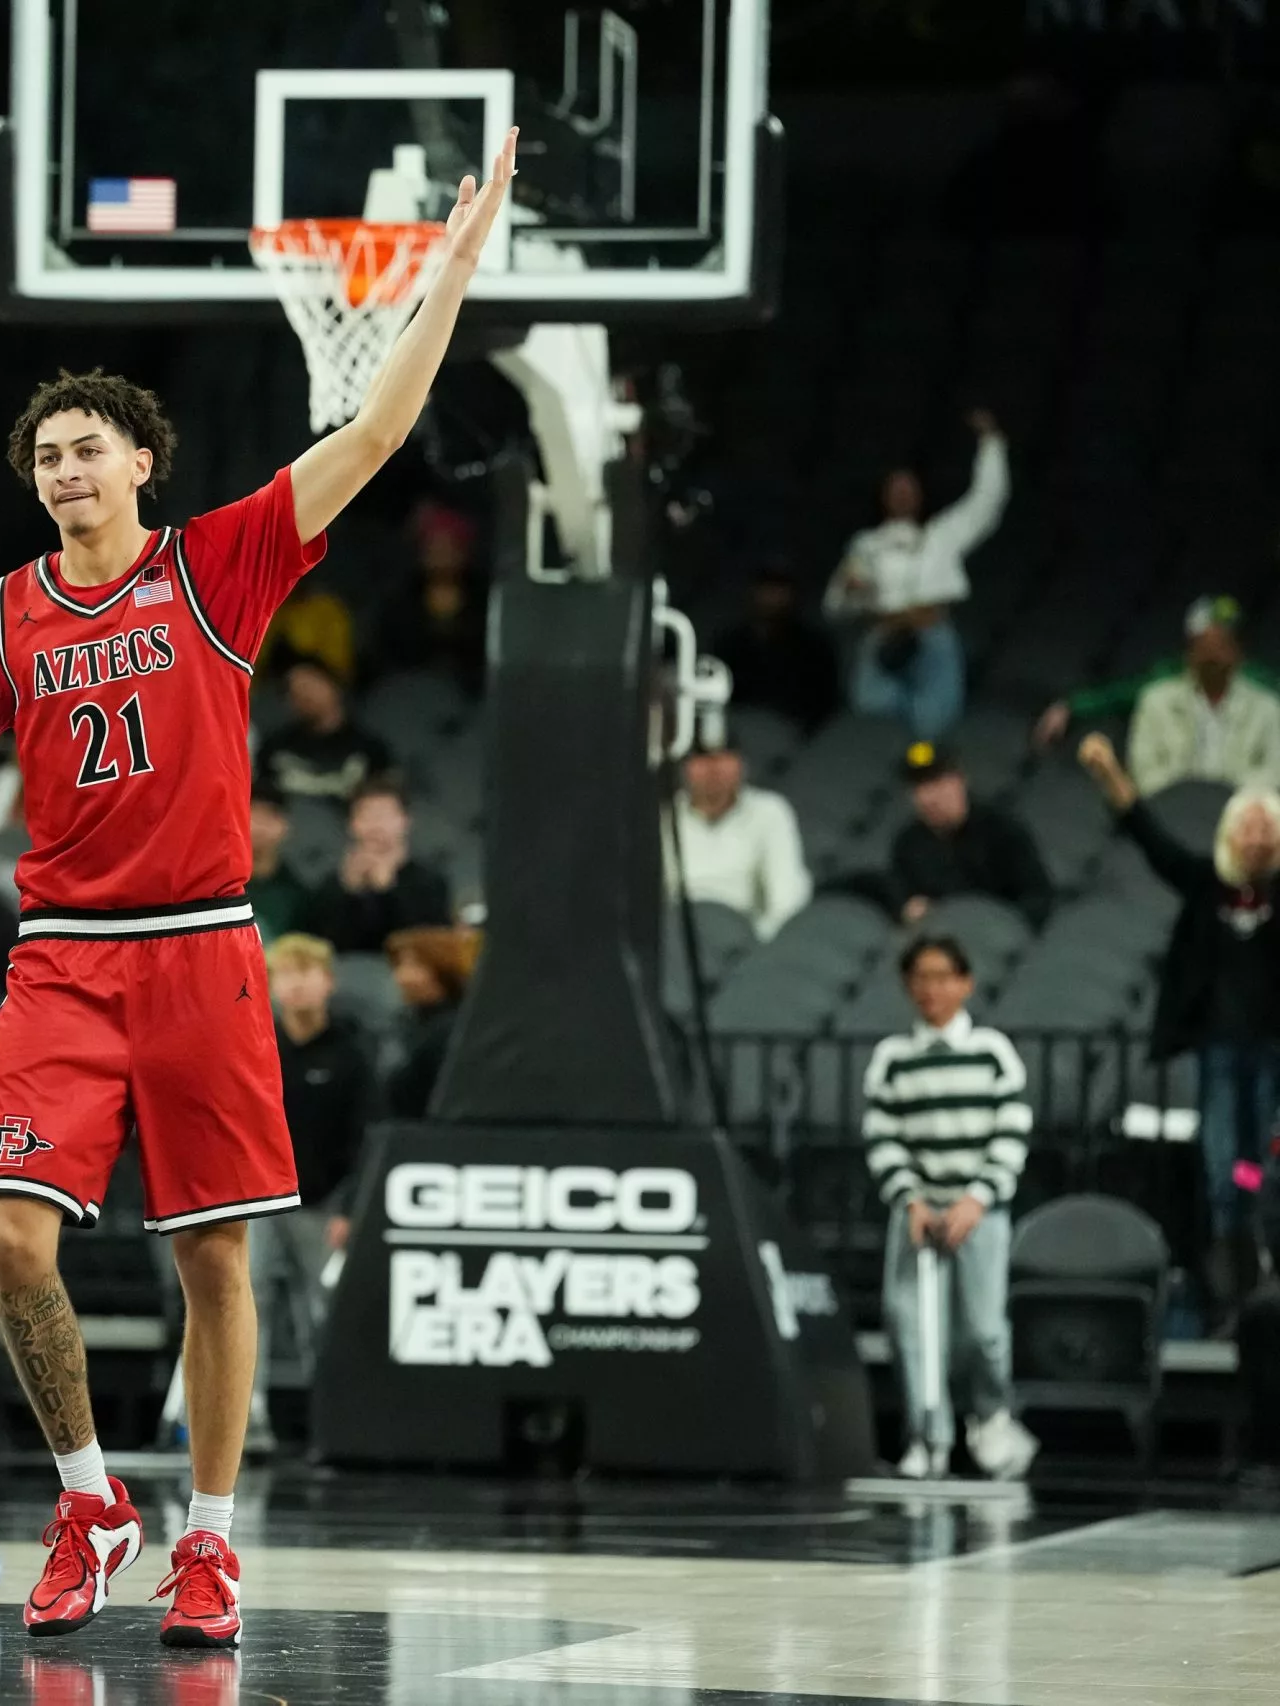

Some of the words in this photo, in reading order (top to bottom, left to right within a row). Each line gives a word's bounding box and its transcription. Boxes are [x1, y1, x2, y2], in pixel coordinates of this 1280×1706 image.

[33, 624, 175, 700] AZTECS
[69, 691, 155, 788] 21
[385, 1162, 698, 1233] GEICO
[390, 1249, 701, 1320] PLAYERS
[395, 1304, 553, 1367] ERA
